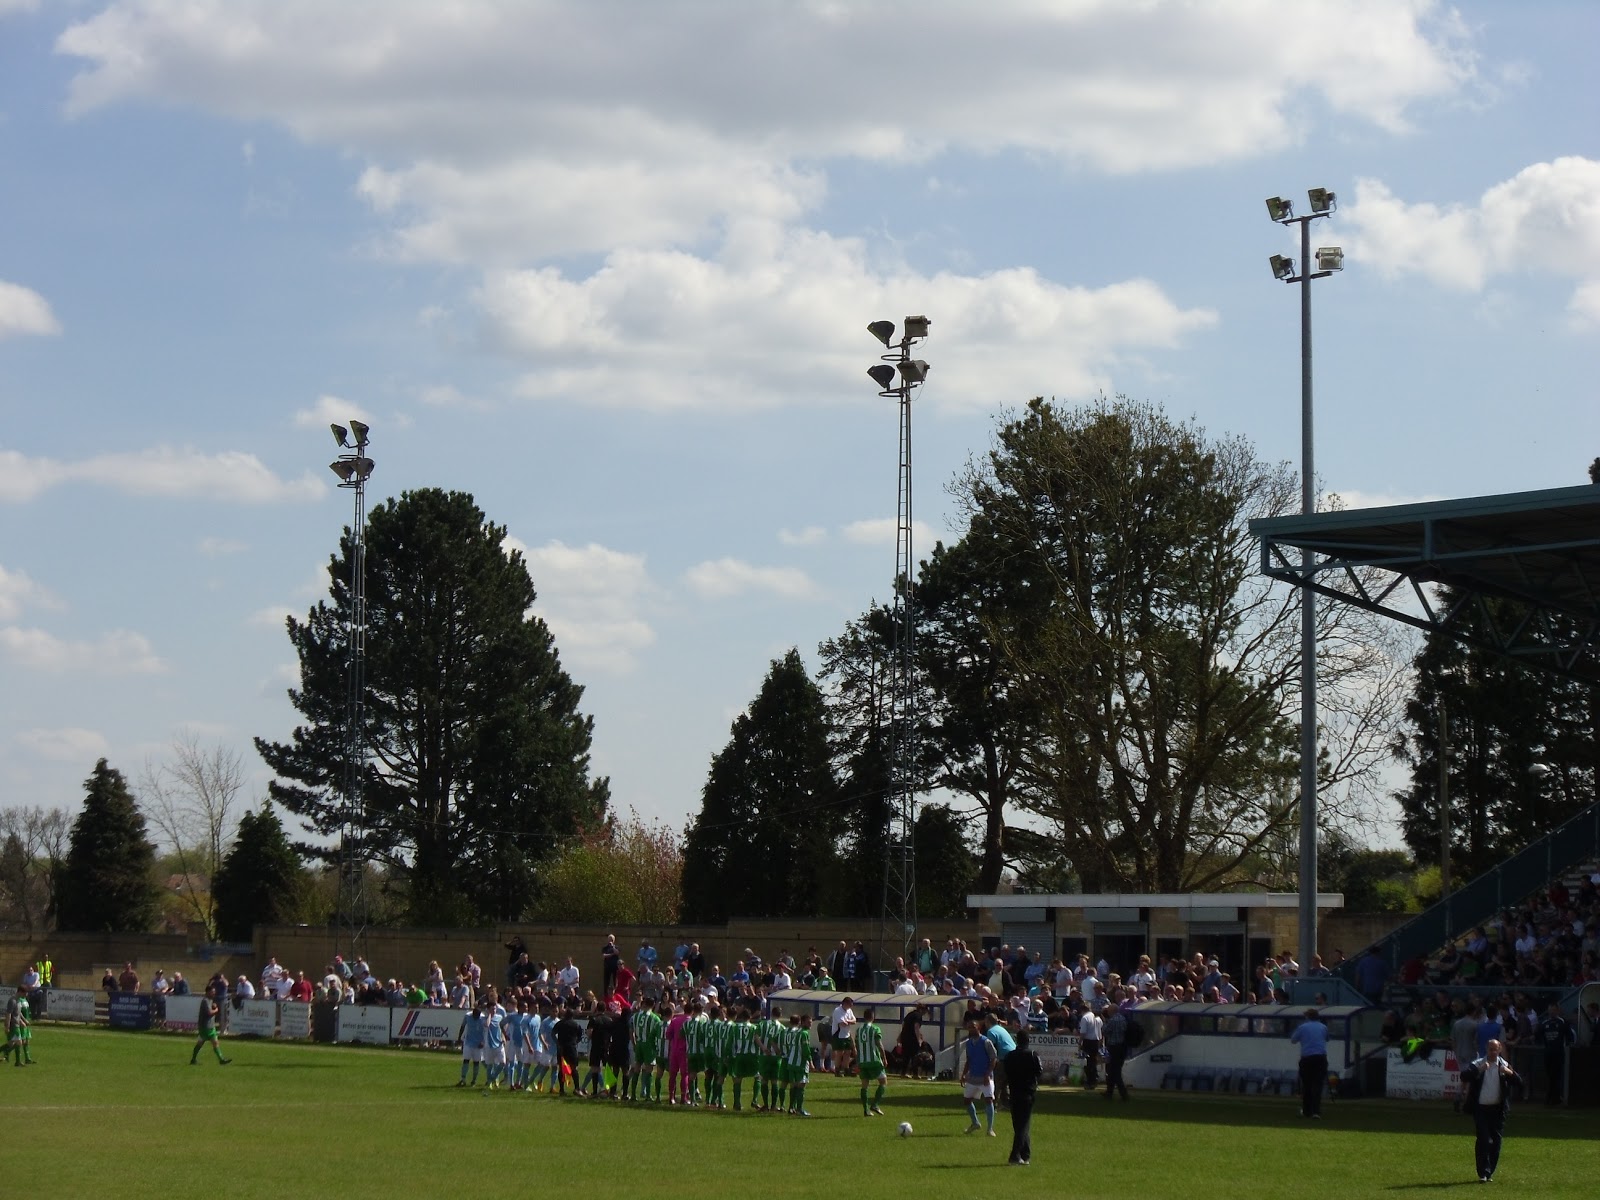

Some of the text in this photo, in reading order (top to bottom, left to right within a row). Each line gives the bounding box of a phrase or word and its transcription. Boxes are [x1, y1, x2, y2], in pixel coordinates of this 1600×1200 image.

[639, 1015, 646, 1027] 5
[414, 1026, 449, 1038] CEMEX
[690, 1023, 695, 1035] 2
[708, 1025, 713, 1038] 3
[739, 1025, 750, 1039] 19
[769, 1025, 776, 1038] 4
[861, 1029, 867, 1042] 6
[1038, 1036, 1069, 1045] COURIER
[1070, 1037, 1080, 1045] EX
[1450, 1073, 1459, 1082] 01
